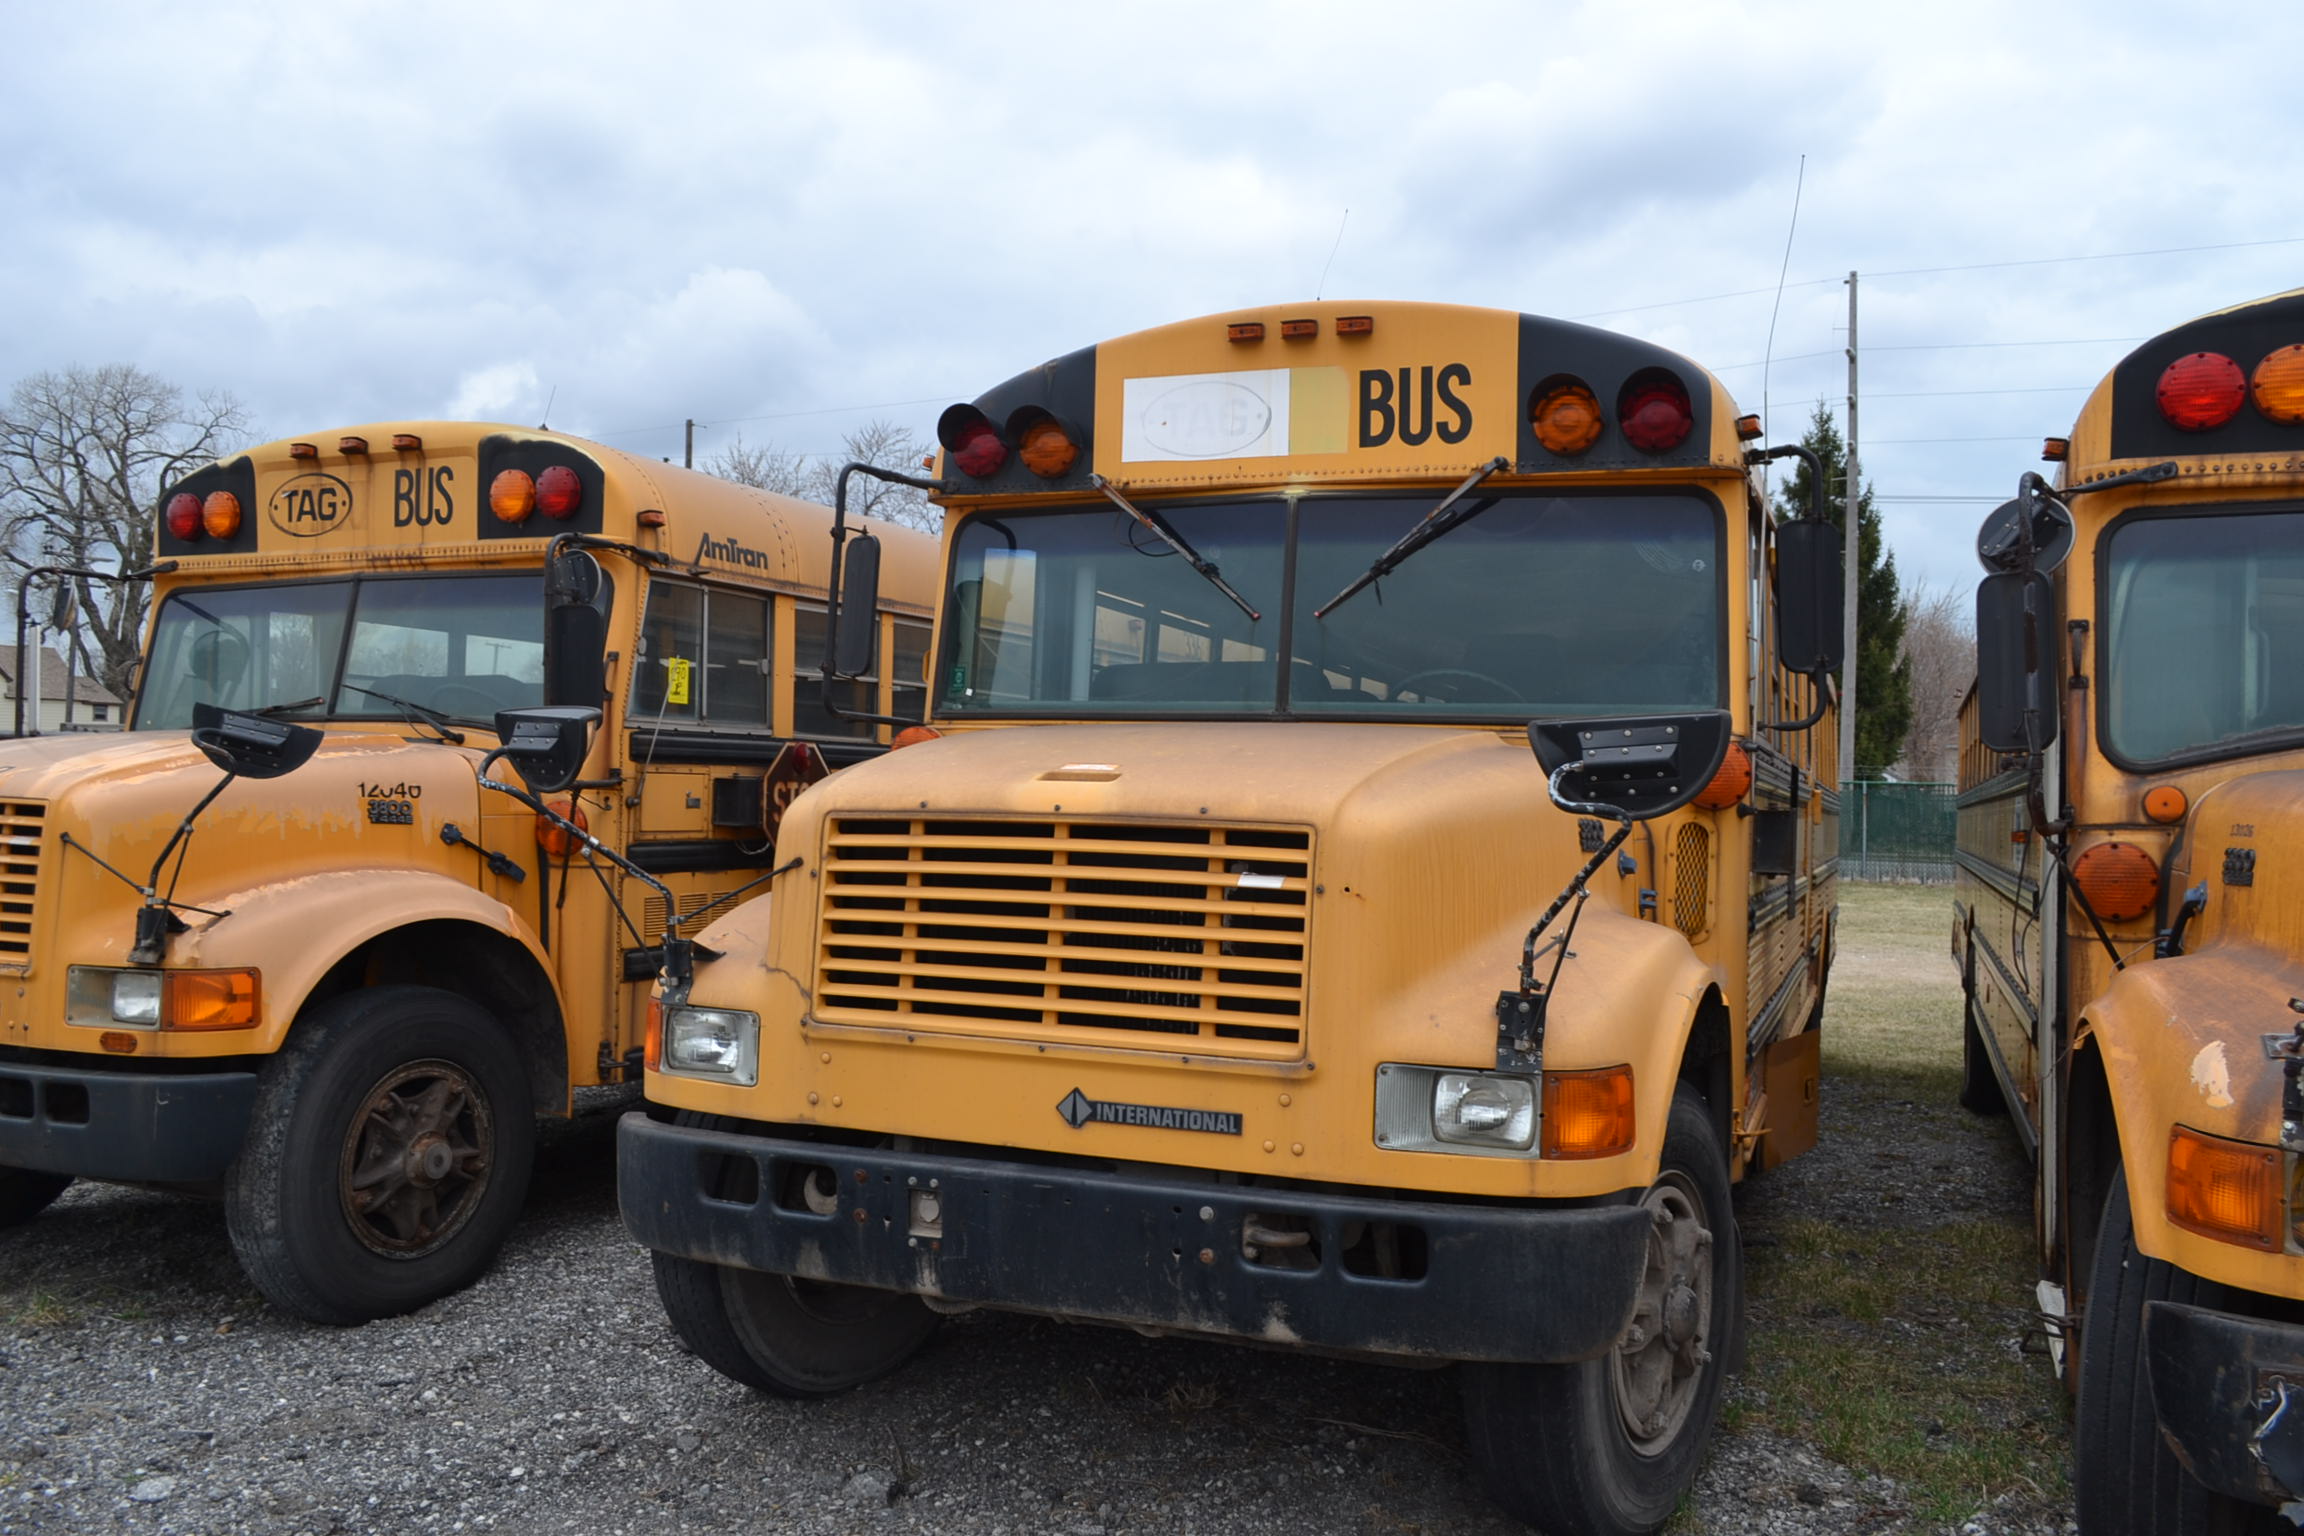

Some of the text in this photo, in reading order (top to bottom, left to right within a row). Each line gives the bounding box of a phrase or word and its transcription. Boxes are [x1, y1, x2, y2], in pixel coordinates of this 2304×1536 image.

[1359, 362, 1473, 449] BUS
[283, 487, 337, 523] TAG
[394, 465, 454, 528] BUS
[693, 532, 769, 570] AmTran
[1096, 1103, 1238, 1133] INTERNATIONAL
